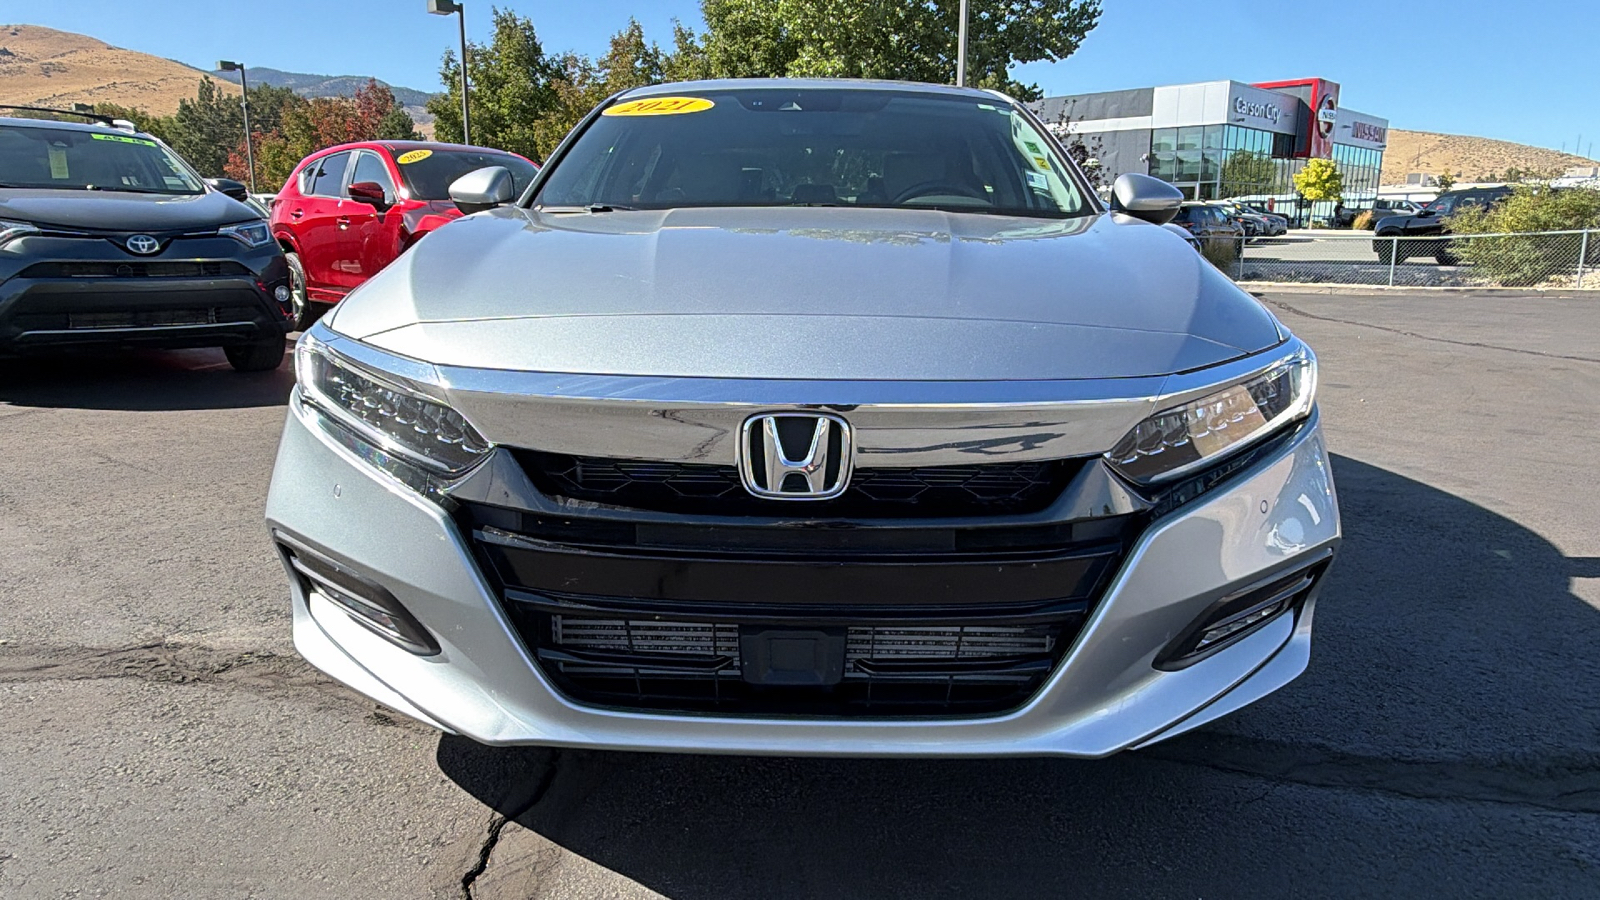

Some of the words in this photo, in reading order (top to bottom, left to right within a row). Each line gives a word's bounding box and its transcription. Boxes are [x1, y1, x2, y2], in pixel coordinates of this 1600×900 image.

[617, 100, 697, 114] 2021
[1236, 97, 1264, 118] Carson
[1266, 104, 1281, 124] City
[1354, 122, 1385, 143] NISSAN
